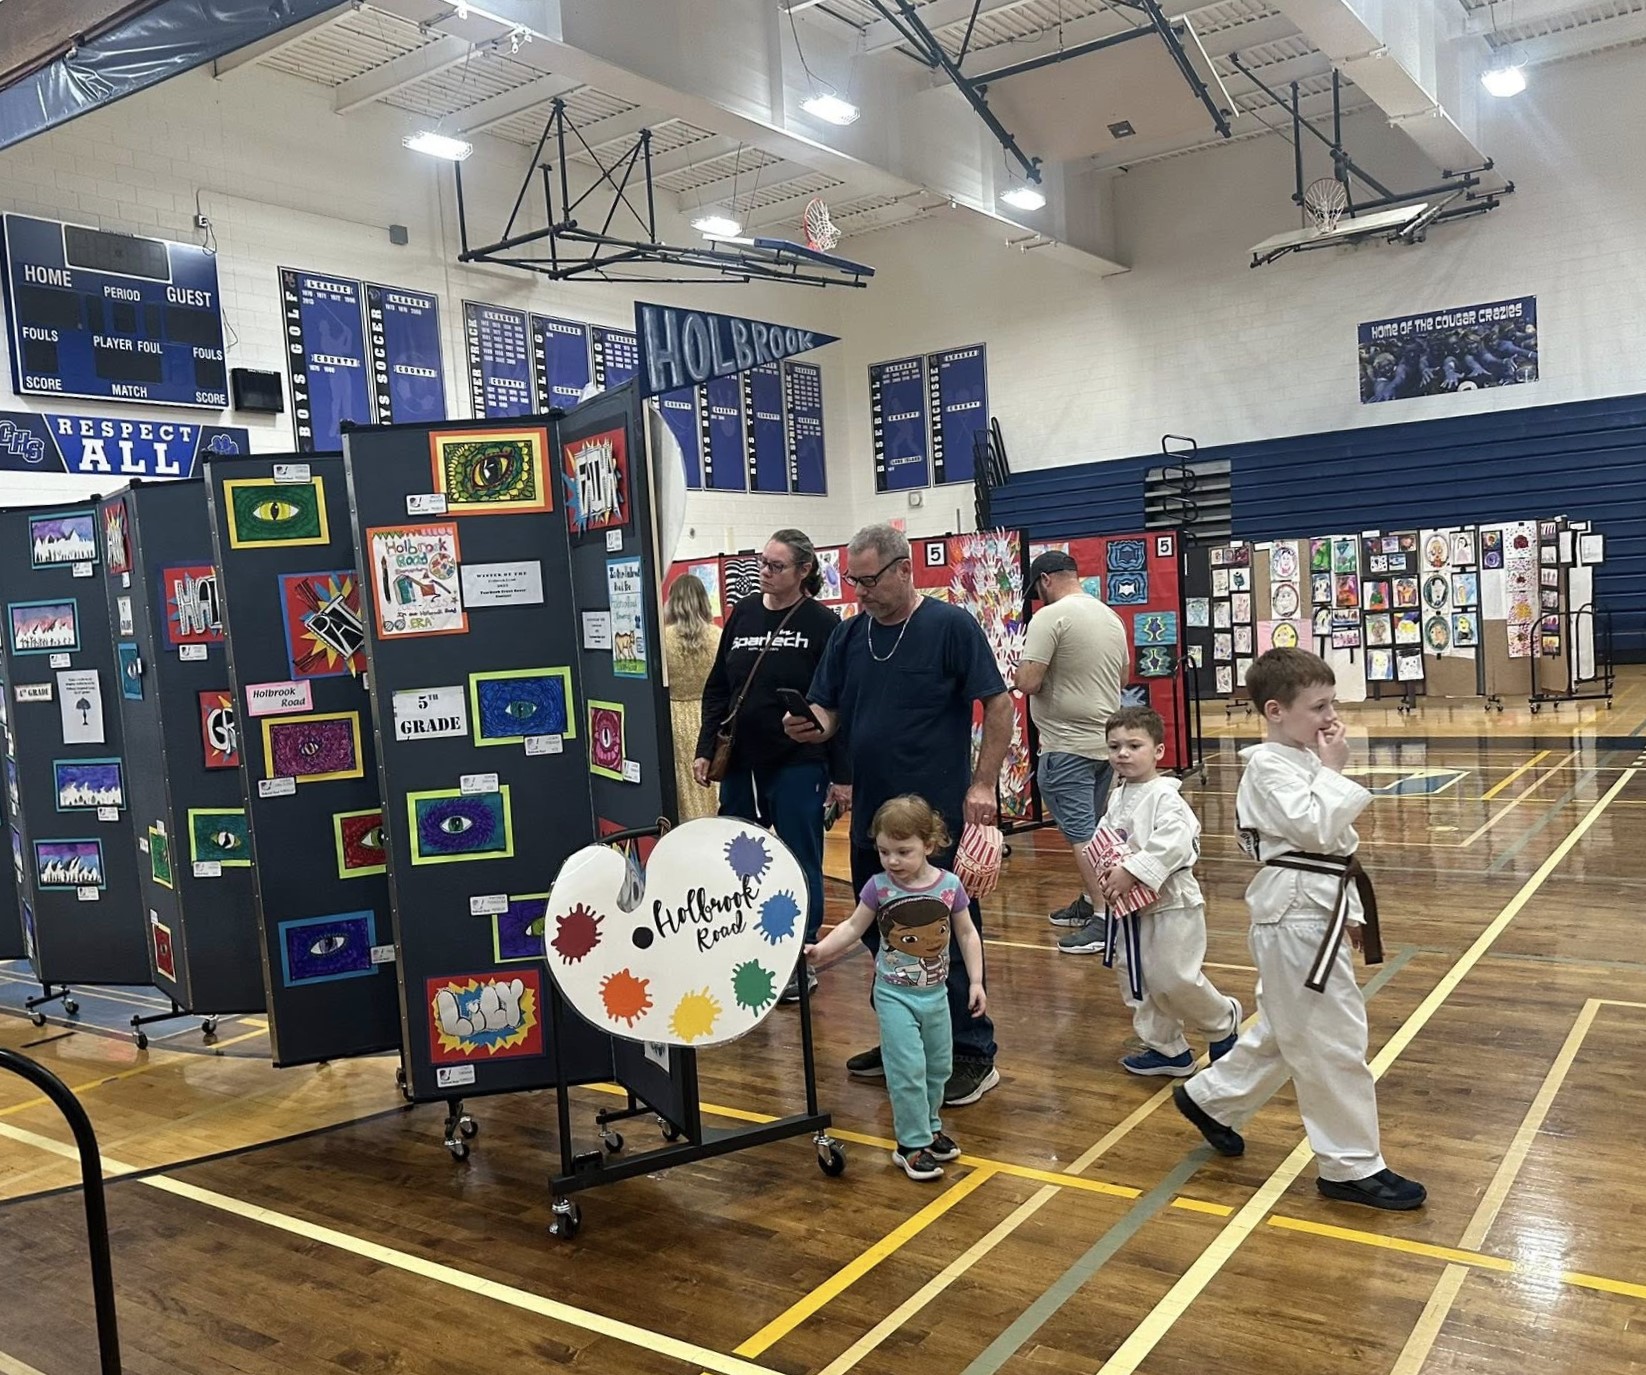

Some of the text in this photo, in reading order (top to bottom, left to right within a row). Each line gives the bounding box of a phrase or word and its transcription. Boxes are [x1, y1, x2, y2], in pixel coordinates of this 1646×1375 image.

[24, 264, 72, 287] HOME
[104, 286, 141, 301] PERIOD
[309, 280, 349, 294] LEAGUE
[167, 287, 211, 307] GUEST
[391, 295, 427, 307] LEAGUE
[285, 291, 304, 354] GOLF
[1400, 323, 1413, 336] OF
[23, 327, 58, 342] FOULS
[94, 336, 163, 354] PLAYER FOUL
[642, 306, 816, 391] HOLBROOK
[193, 347, 223, 361] FOULS
[316, 355, 354, 366] COUNTY
[371, 309, 392, 424] YS SOCCER
[398, 366, 433, 376] COUNTY
[467, 319, 486, 419] WINTER TRACK
[534, 334, 549, 414] STLING
[594, 343, 606, 392] NCING
[26, 376, 62, 391] SCORE
[112, 384, 148, 397] MATCH
[555, 387, 580, 395] COUNT
[196, 391, 226, 405] SCORE
[293, 373, 311, 437] BOYS
[930, 367, 943, 466] BOYS LACROSSE
[57, 418, 192, 442] RESPECT
[700, 383, 712, 473] BOYS BOWL
[786, 374, 798, 481] BOYS SPRING TRACK
[872, 381, 885, 472] BASEBALL
[79, 438, 180, 475] ALL
[748, 436, 757, 474] BOYS
[385, 538, 448, 555] Holbrook
[930, 547, 941, 561] 5
[1160, 540, 1169, 553] 5
[396, 552, 428, 567] Road
[410, 617, 432, 629] ERA
[28, 688, 49, 697] GRADE
[253, 687, 296, 698] Holbrook
[281, 698, 306, 707] Road
[400, 717, 461, 735] GRADE
[653, 873, 760, 938] Holbrook
[697, 910, 746, 953] Road
